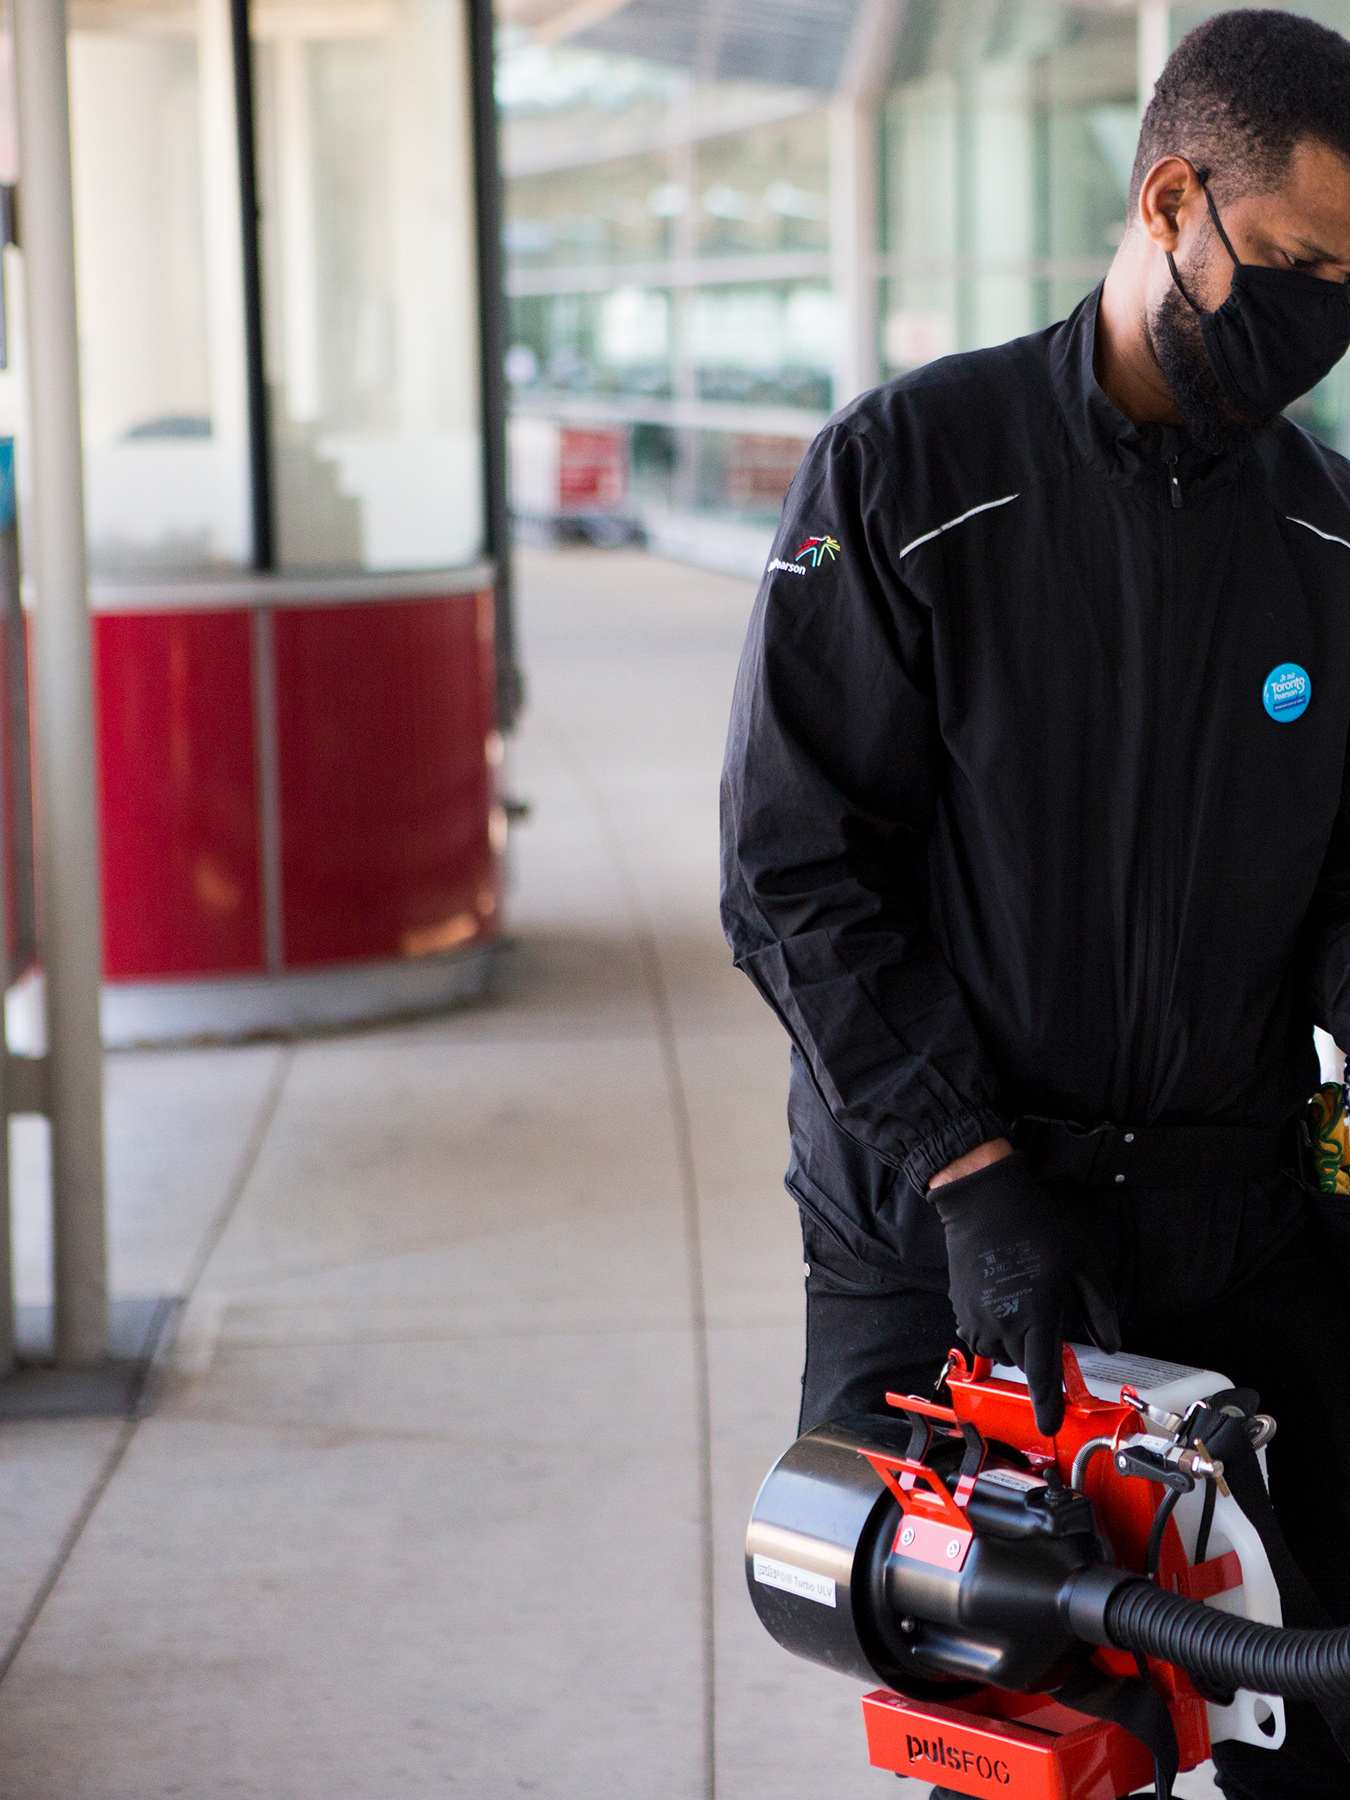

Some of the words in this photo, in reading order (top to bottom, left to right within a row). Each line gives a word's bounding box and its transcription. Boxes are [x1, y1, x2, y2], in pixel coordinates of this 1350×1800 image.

[1271, 677, 1305, 694] Toronto
[1274, 689, 1298, 701] Pearson
[794, 1576, 815, 1592] Turbo
[817, 1583, 833, 1597] ULV
[906, 1734, 1010, 1784] pulsFOG
